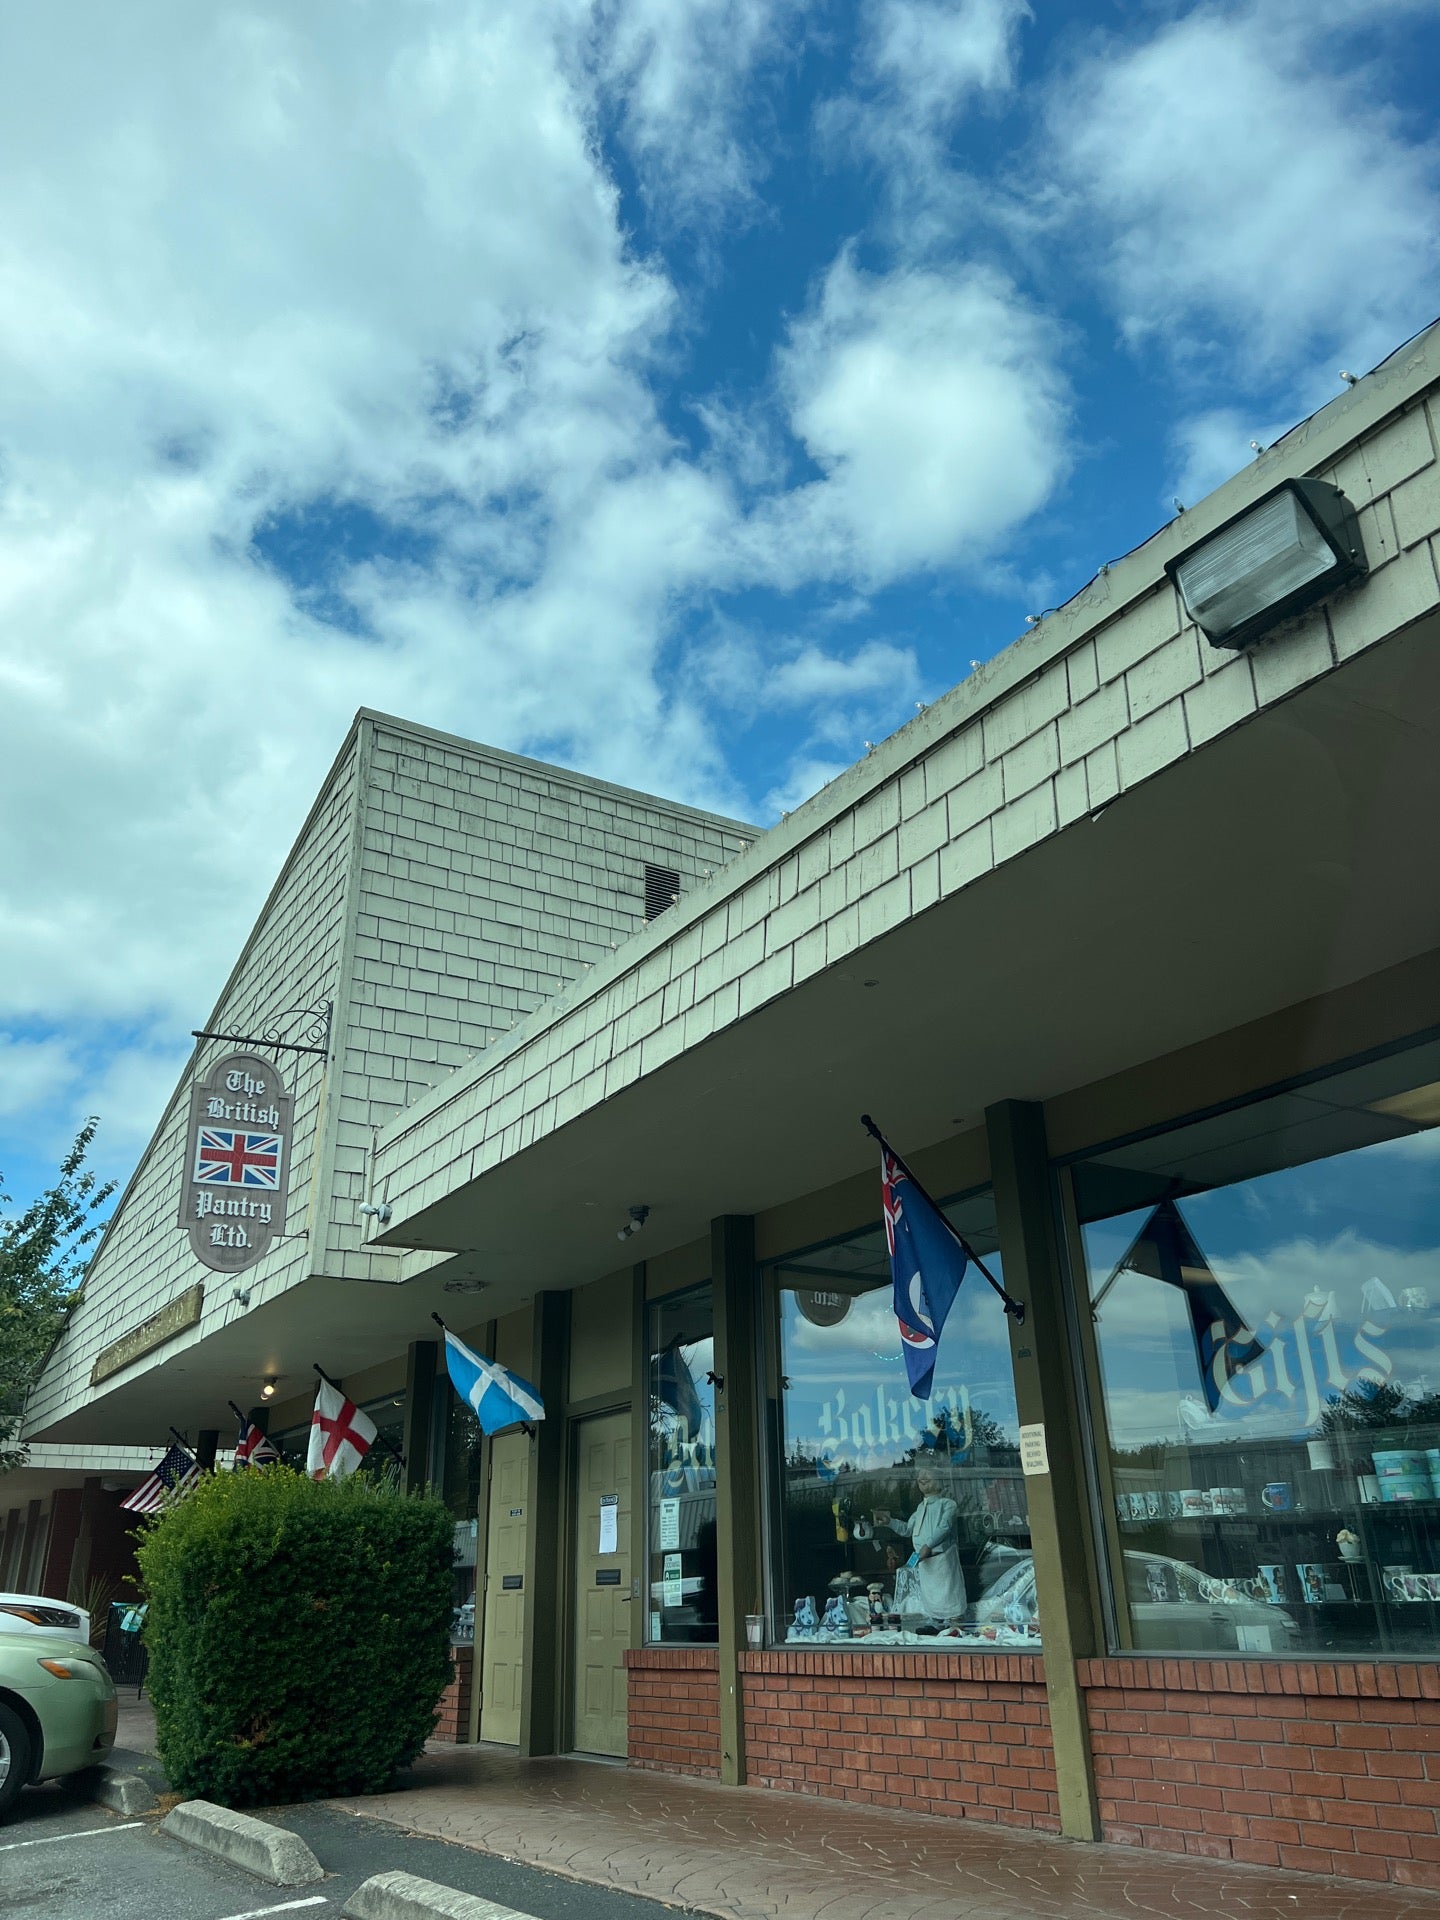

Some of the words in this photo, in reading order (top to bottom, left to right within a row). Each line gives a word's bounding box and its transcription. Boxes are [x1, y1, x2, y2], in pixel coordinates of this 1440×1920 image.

[226, 1070, 266, 1099] The
[207, 1097, 280, 1130] British
[195, 1190, 272, 1224] Pantry
[210, 1223, 253, 1249] Ltd.
[1210, 1302, 1393, 1427] Gifts
[818, 1383, 974, 1471] Bakery
